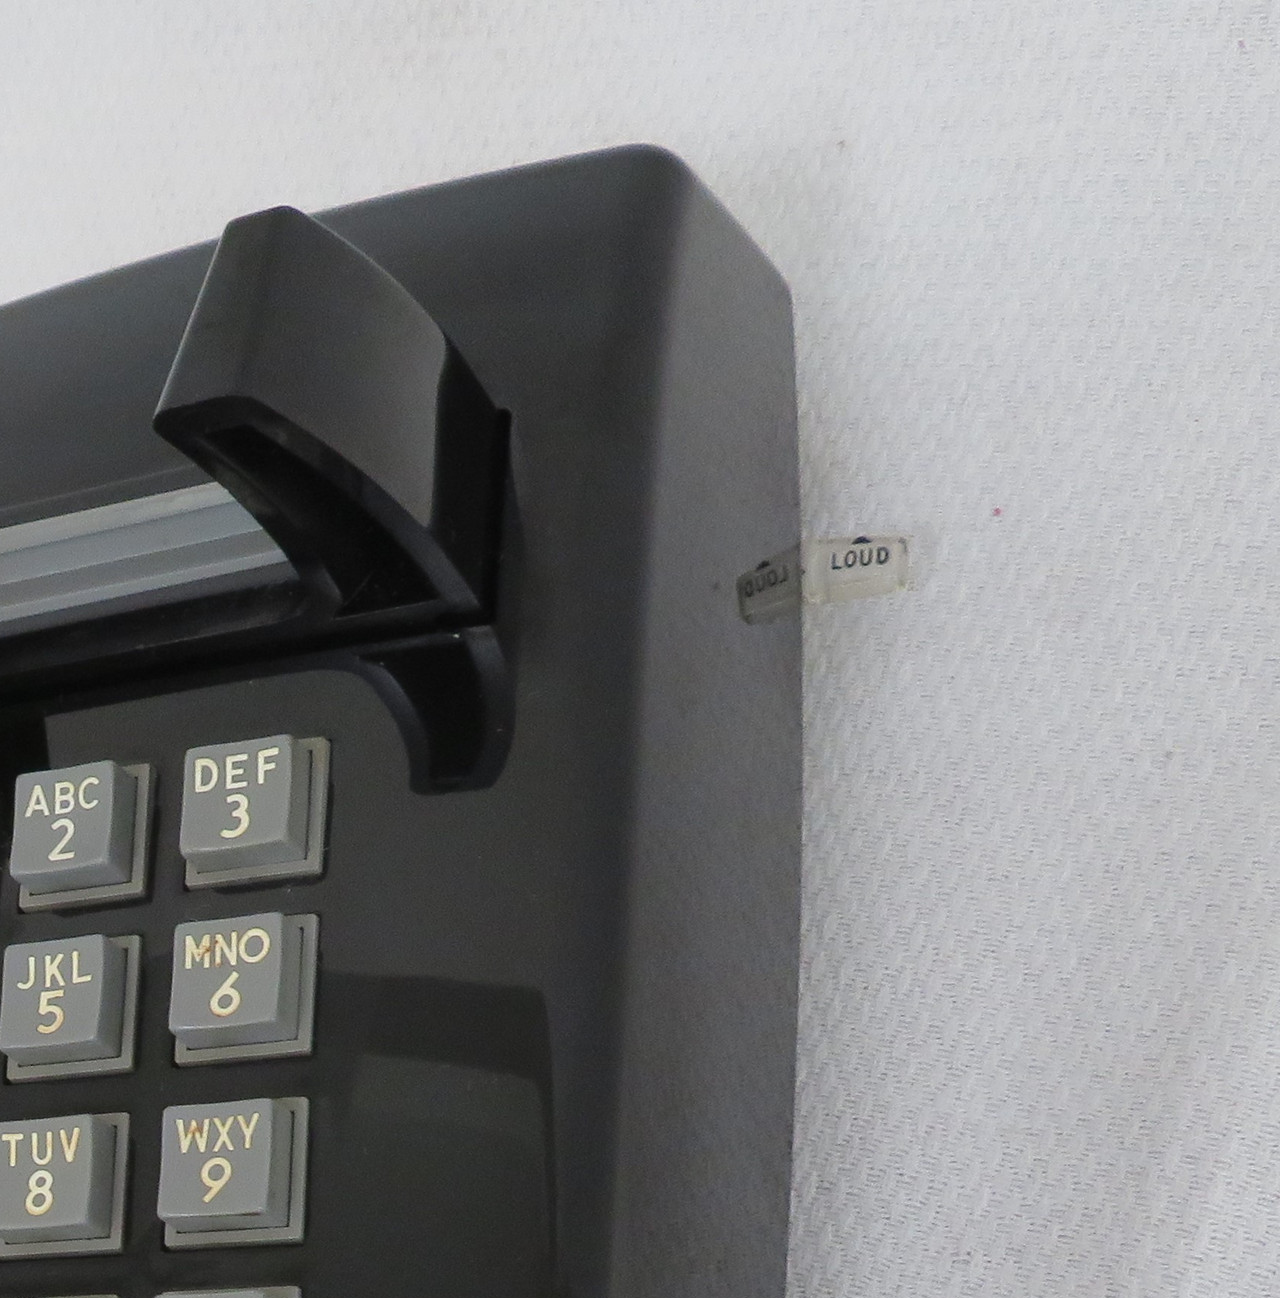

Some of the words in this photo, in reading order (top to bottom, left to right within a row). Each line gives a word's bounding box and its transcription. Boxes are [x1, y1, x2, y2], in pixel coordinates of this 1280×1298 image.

[831, 546, 890, 571] LOUD
[194, 747, 279, 794] DEF
[24, 777, 100, 818] ABC
[220, 793, 250, 839] 3
[48, 818, 75, 861] 2
[16, 950, 92, 990] JKL
[185, 928, 270, 971] MNO
[37, 989, 64, 1034] 5
[210, 971, 241, 1016] 6
[1, 1127, 80, 1167] TUV
[176, 1112, 260, 1154] WXY
[25, 1169, 53, 1216] 8
[201, 1157, 232, 1203] 9
